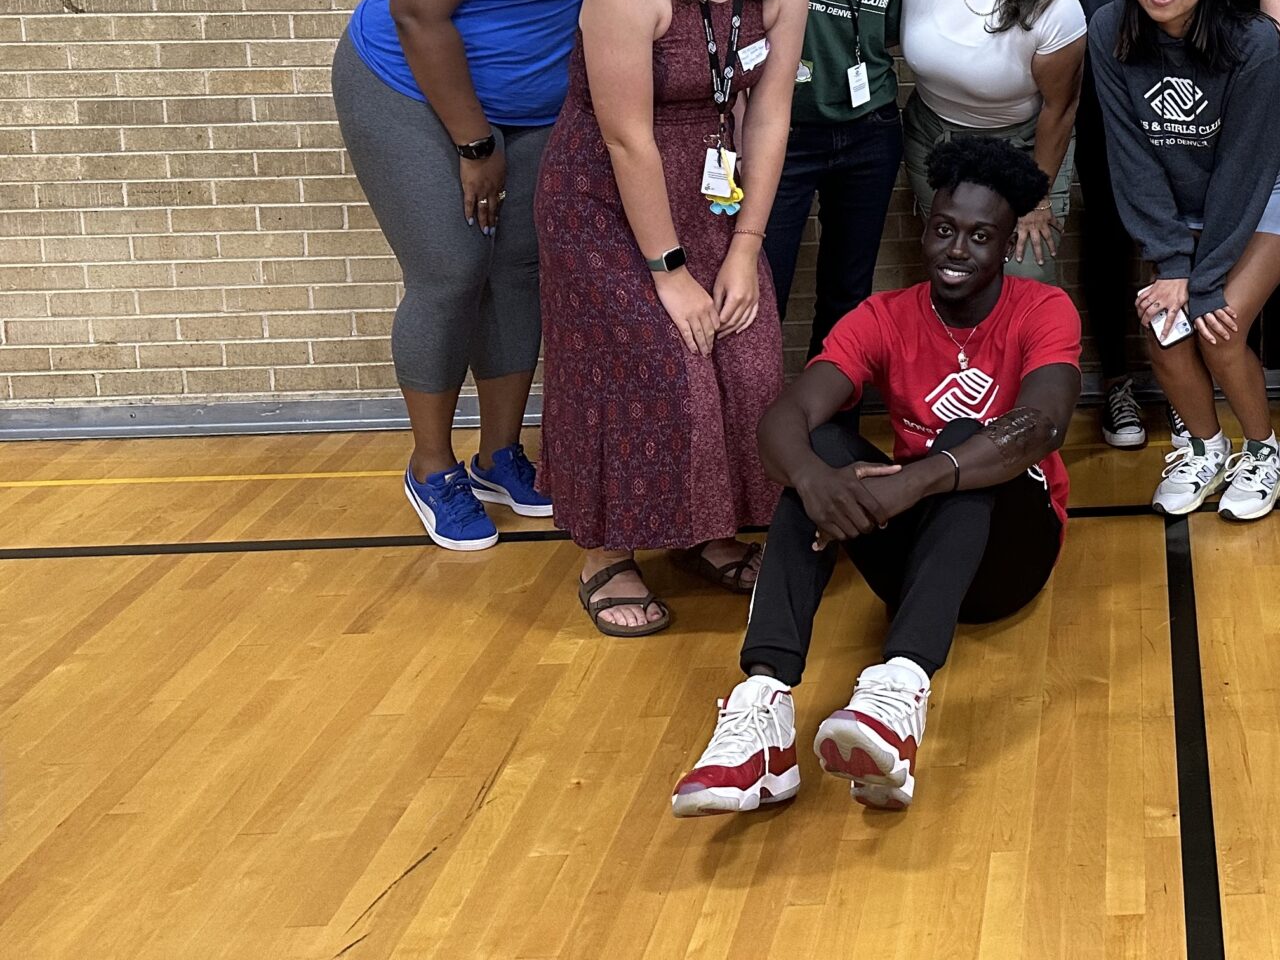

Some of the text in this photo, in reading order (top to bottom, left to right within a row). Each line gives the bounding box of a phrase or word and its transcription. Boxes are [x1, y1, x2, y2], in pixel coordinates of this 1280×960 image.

[808, 1, 858, 19] ETRO DENVE
[1151, 121, 1161, 131] &
[1163, 122, 1196, 134] GIRLS
